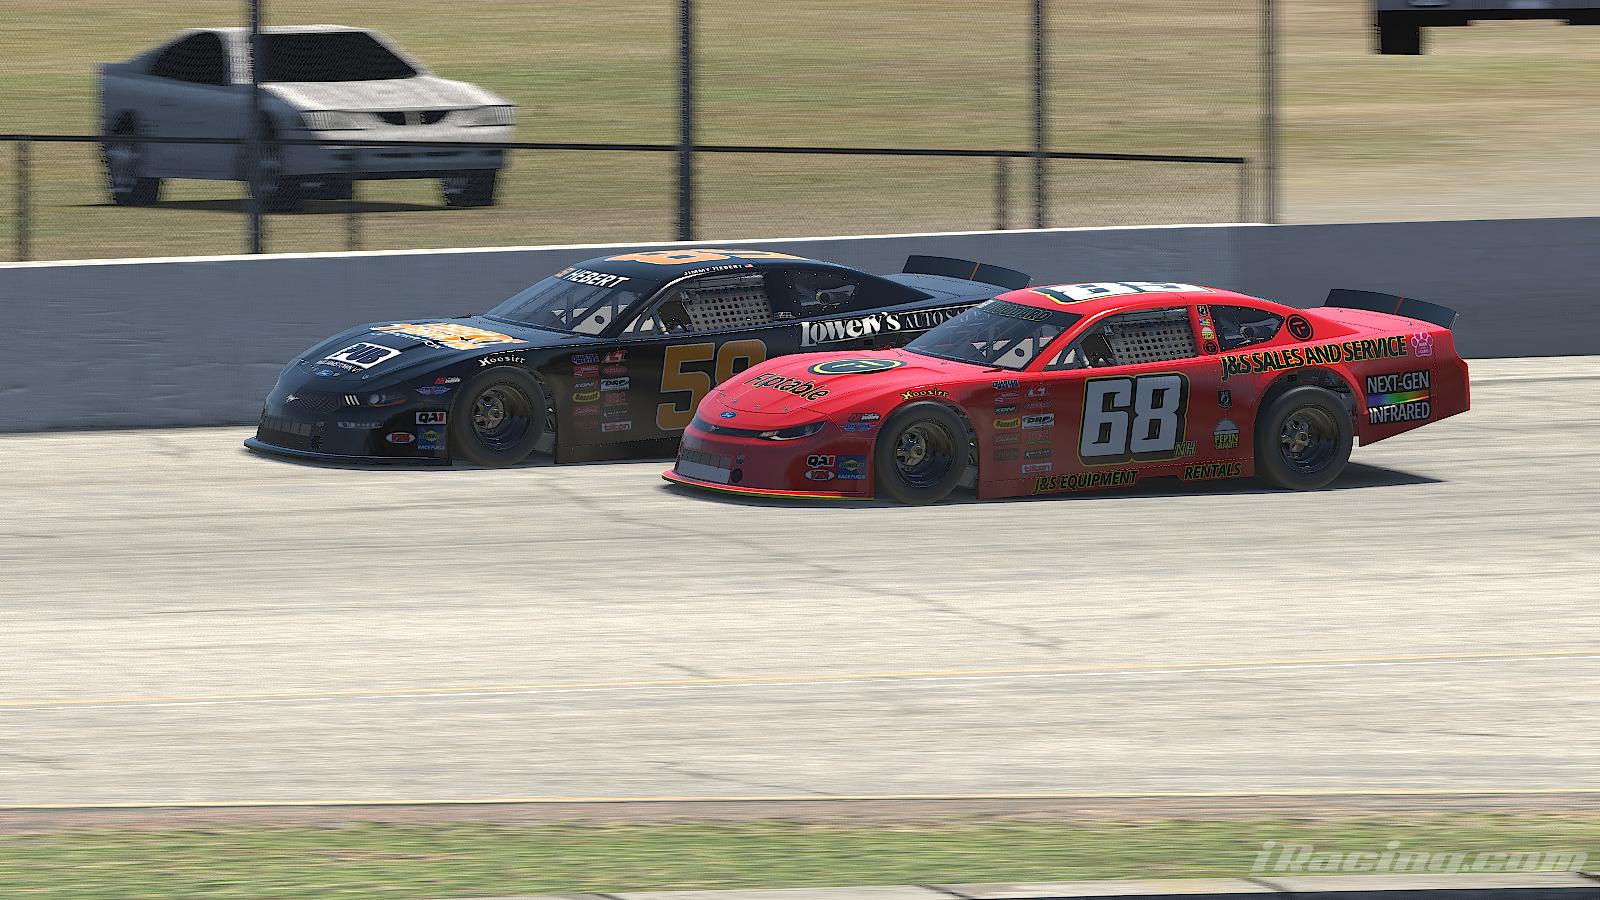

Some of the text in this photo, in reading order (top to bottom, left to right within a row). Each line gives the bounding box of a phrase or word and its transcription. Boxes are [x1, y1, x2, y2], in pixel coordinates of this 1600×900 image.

[563, 268, 632, 288] HEBERT
[684, 264, 743, 276] JIMMY HEBERT
[478, 354, 526, 367] Hoosier
[1220, 354, 1252, 382] J&S
[1252, 348, 1304, 373] SALES
[1304, 343, 1343, 366] AND
[1342, 335, 1408, 362] SERVICE
[1367, 371, 1430, 394] NEXT-GEN
[901, 388, 949, 400] Hoosier
[1079, 373, 1188, 463] 68
[1369, 401, 1431, 424] INFRARED
[1214, 433, 1239, 444] PEPIN
[1032, 462, 1242, 495] J&S EQUIPMENT RENTALS
